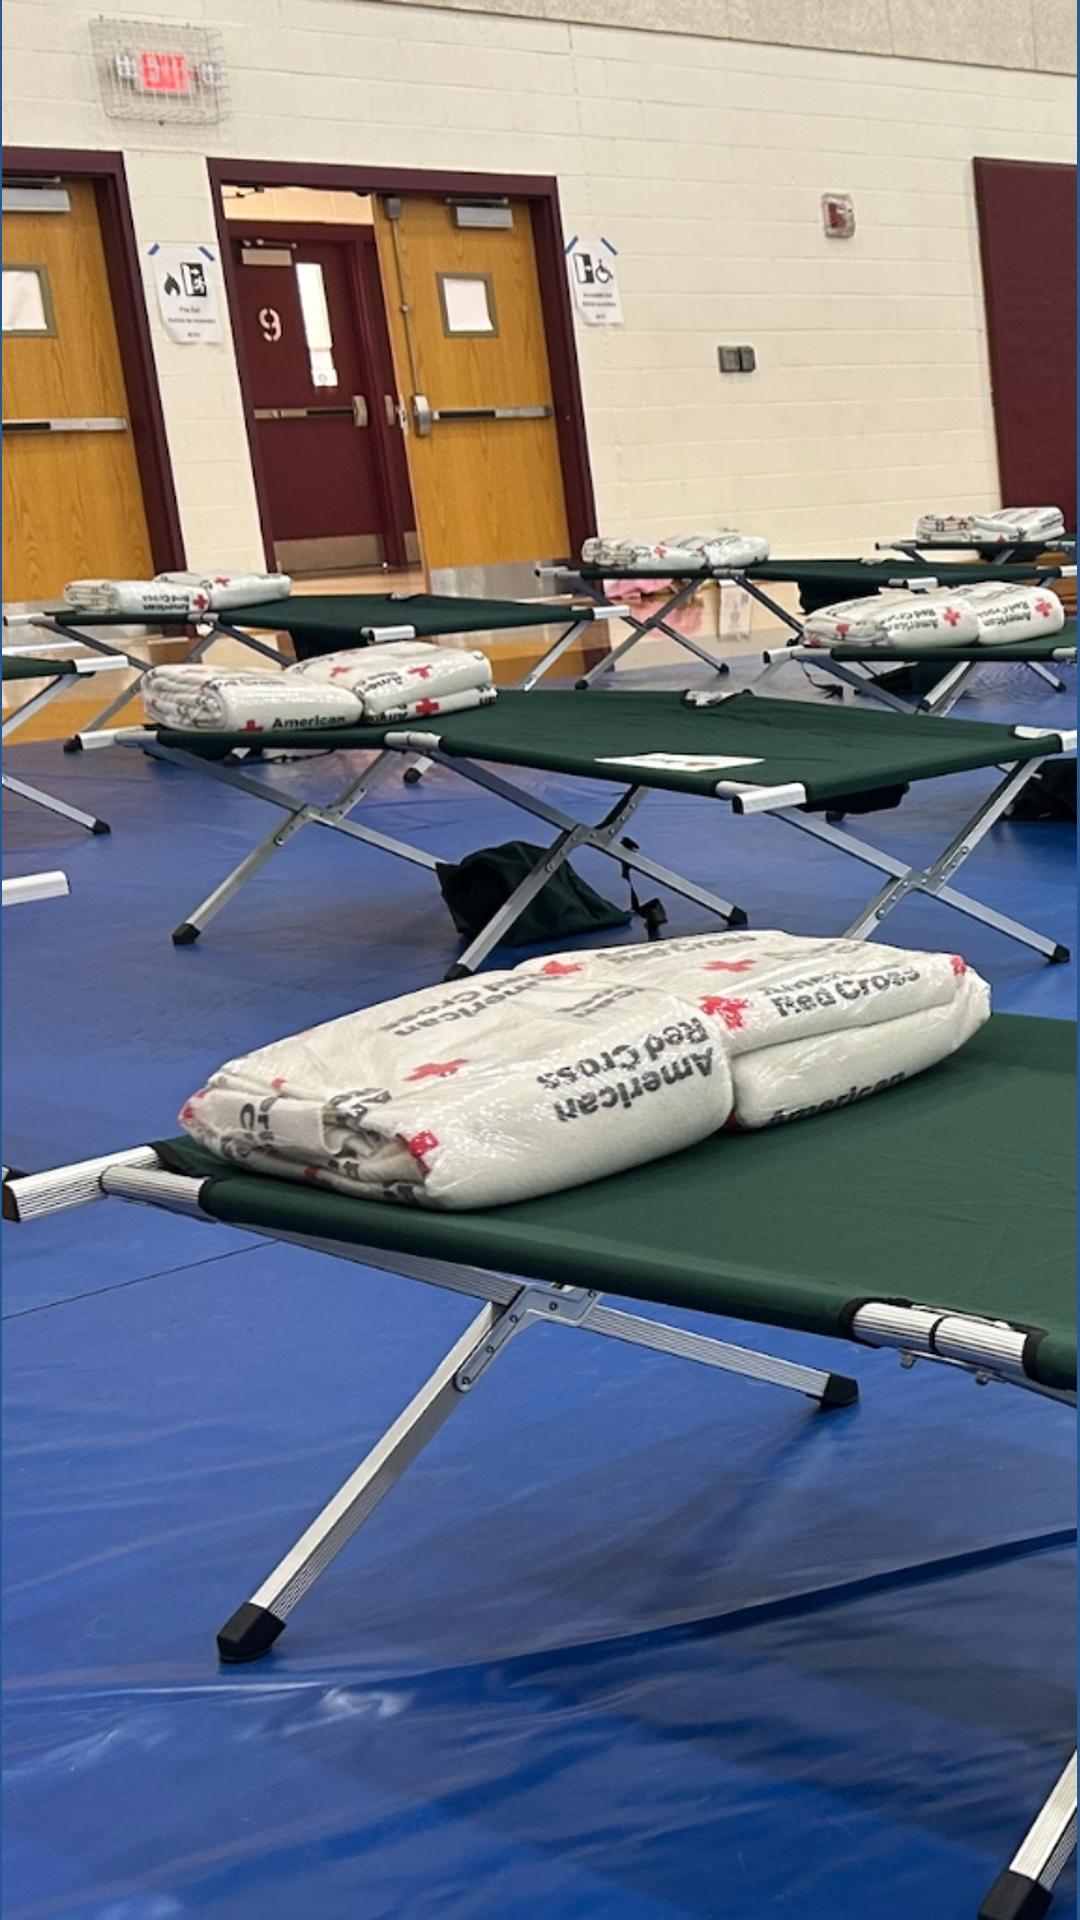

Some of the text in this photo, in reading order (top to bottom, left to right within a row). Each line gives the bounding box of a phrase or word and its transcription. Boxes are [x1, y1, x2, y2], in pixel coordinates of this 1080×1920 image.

[142, 52, 187, 90] EXIT
[259, 307, 282, 342] 9
[272, 715, 346, 730] American
[771, 967, 921, 1018] Red Cross
[536, 1017, 709, 1090] Red Cross
[553, 1047, 713, 1122] American
